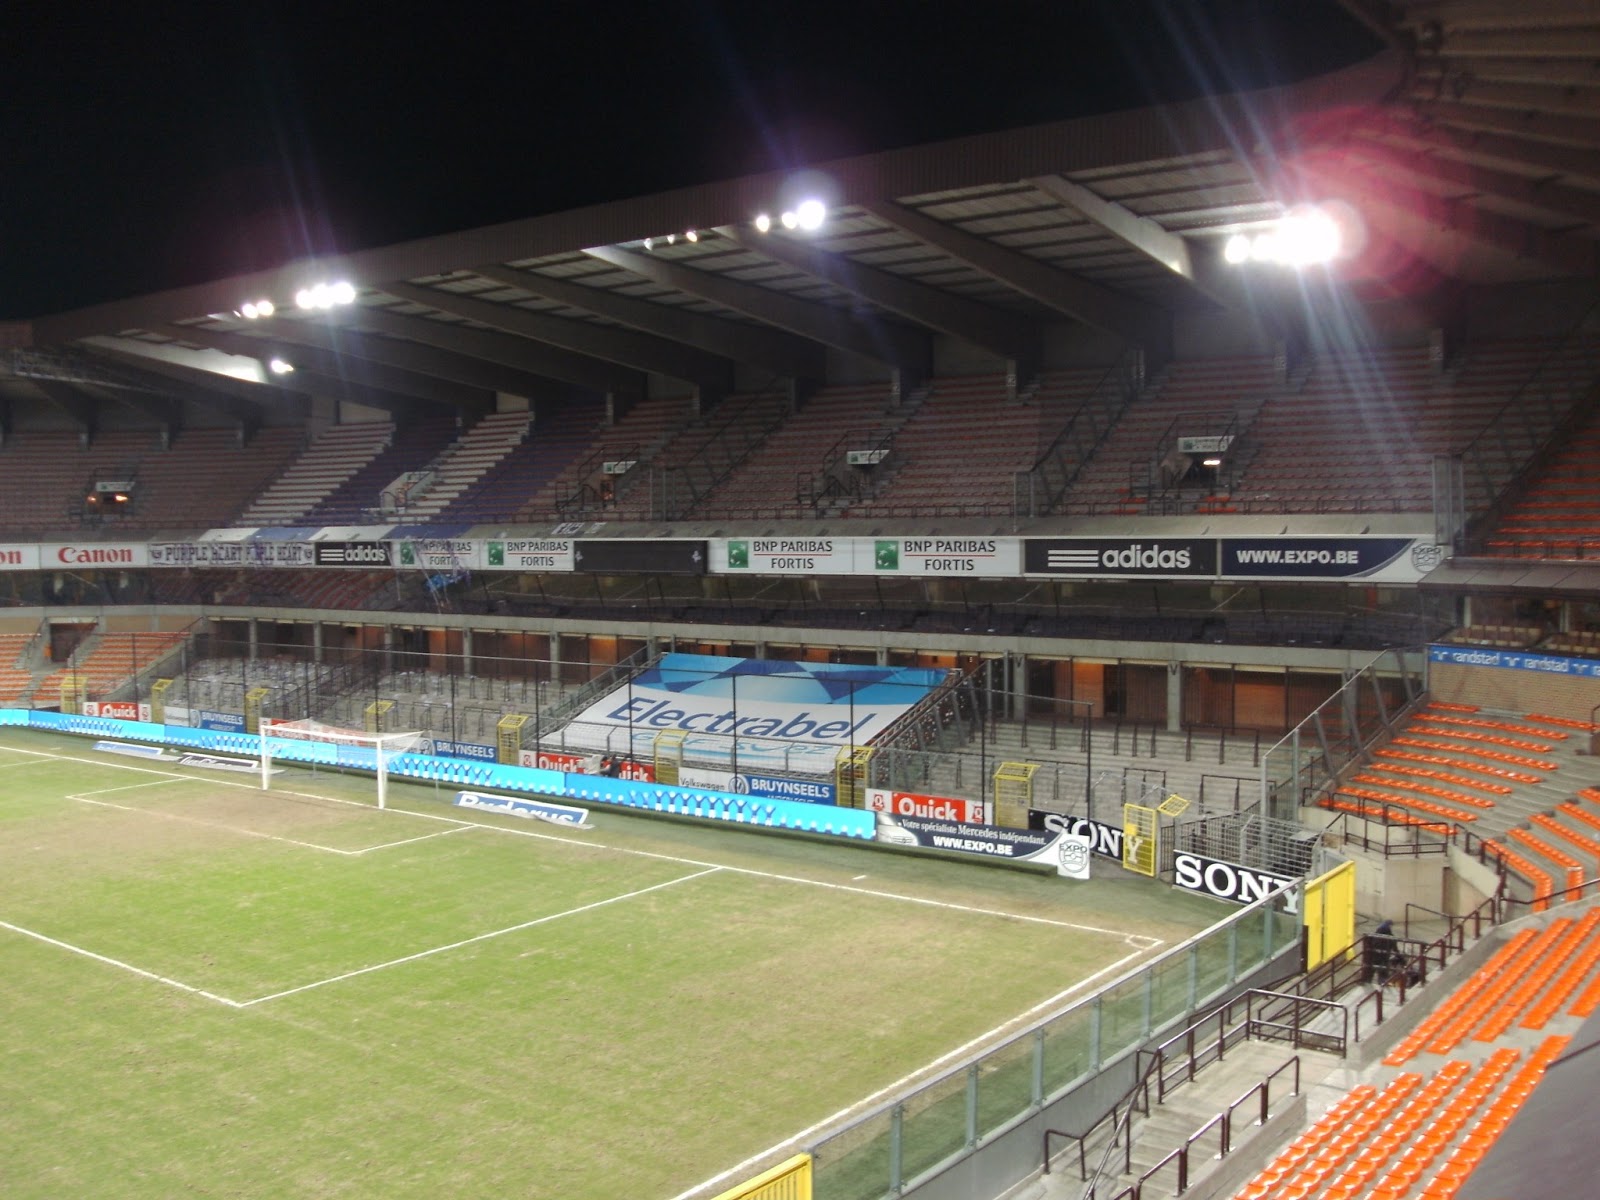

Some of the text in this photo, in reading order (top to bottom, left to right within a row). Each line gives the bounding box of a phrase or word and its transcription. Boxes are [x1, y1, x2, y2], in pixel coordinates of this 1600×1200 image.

[165, 546, 208, 561] PURPLE
[345, 546, 386, 562] adidas
[507, 541, 568, 551] BNP PARIBAS
[753, 541, 833, 552] BNP PARIBAS
[904, 541, 996, 553] BNP PARIBAS
[57, 546, 133, 563] Canon
[521, 556, 554, 566] FORTIS
[1102, 545, 1191, 568] adidas
[1236, 550, 1359, 564] WWW.EXPO.BE
[771, 558, 814, 569] FORTIS
[924, 559, 975, 571] FORTIS
[1452, 651, 1569, 673] randstad randstad
[100, 704, 137, 719] Quick
[606, 697, 876, 739] Electrabel
[436, 742, 495, 759] BRUYNSEELS
[680, 776, 726, 791] Volkswagen
[751, 778, 830, 798] BRUYNSEELS
[899, 798, 959, 821] Quick
[902, 819, 920, 829] Votre
[920, 822, 958, 834] spécialiste
[958, 825, 999, 839] Mercedes
[933, 836, 1013, 855] WWW.EXPO.BE
[1044, 813, 1143, 864] SONY
[1059, 842, 1088, 853] EXPO
[1175, 854, 1299, 914] SONY
